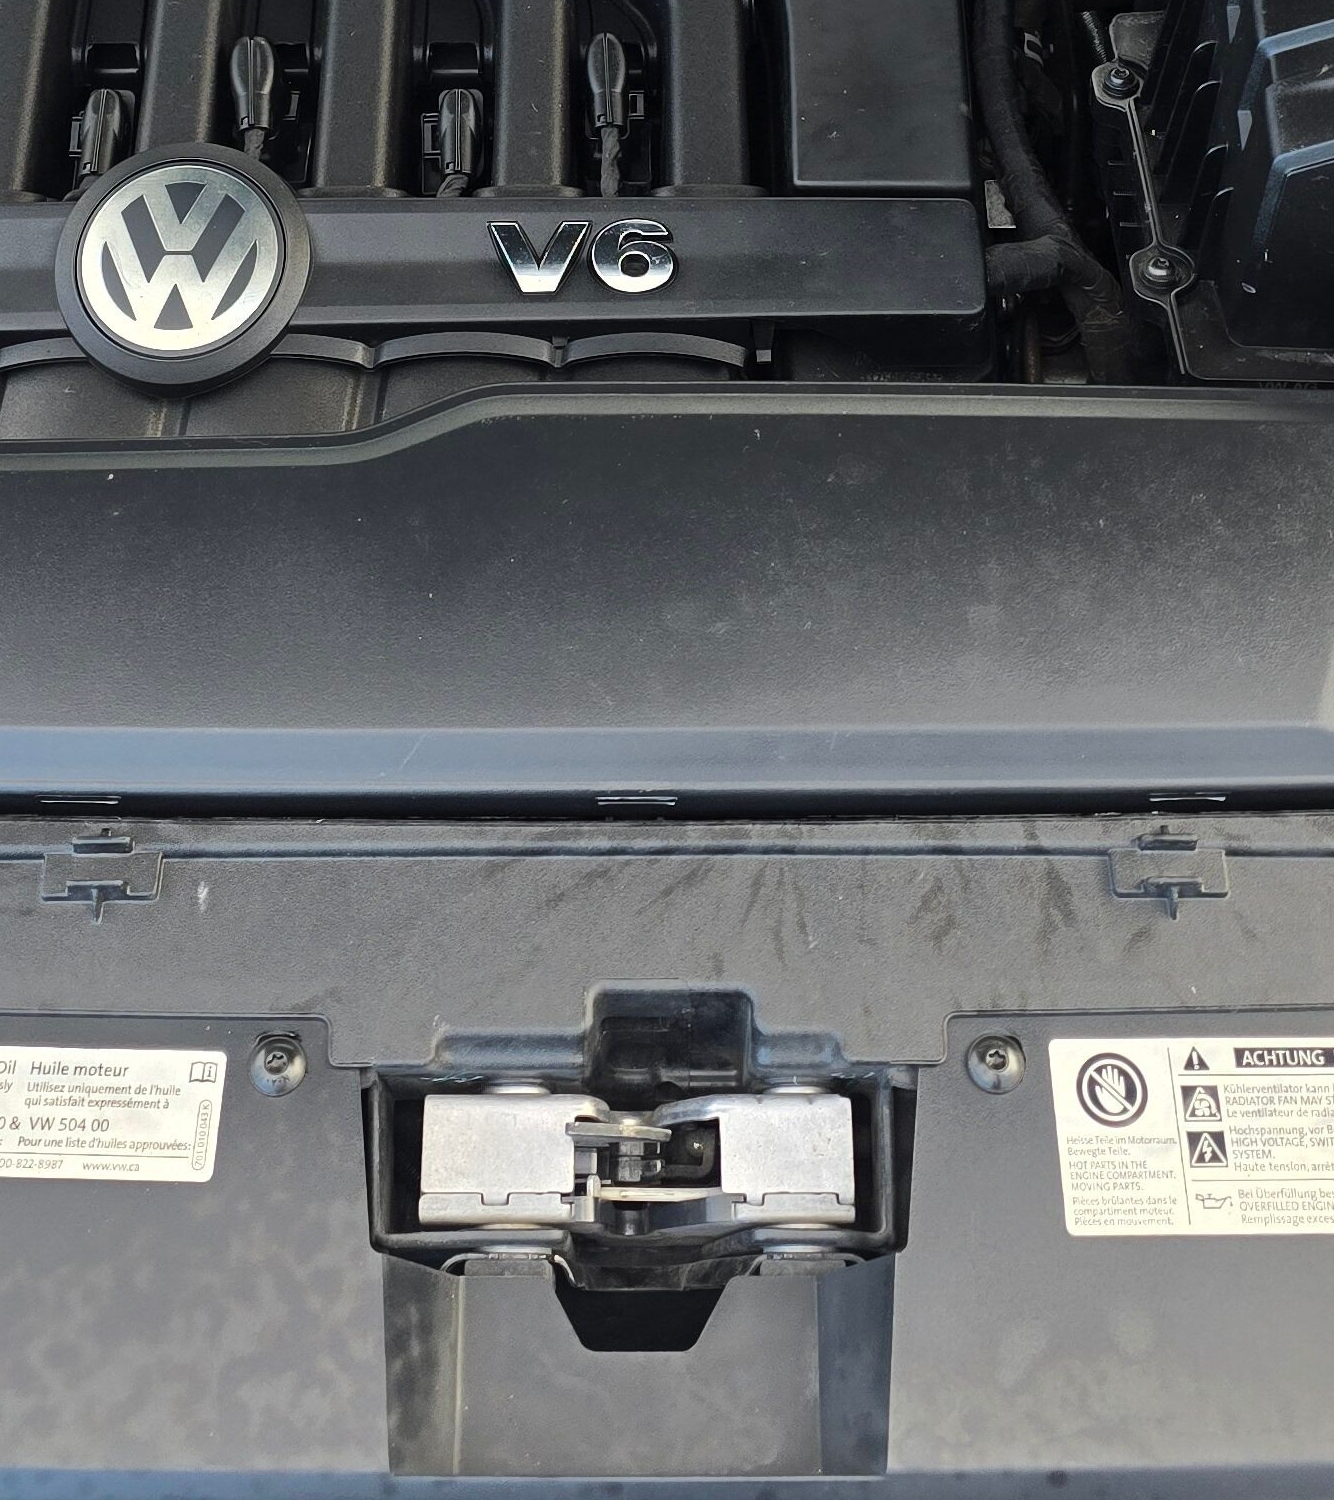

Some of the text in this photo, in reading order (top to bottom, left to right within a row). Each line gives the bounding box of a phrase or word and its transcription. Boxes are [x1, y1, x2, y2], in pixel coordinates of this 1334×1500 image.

[486, 218, 679, 295] V6
[1241, 1048, 1326, 1067] ACHTUNG
[29, 1060, 130, 1078] Huile moteur
[26, 1080, 182, 1097] Utilisez uniquement de l'huile
[1222, 1082, 1304, 1098] Kühlerventilator
[1304, 1082, 1333, 1098] kann
[23, 1094, 171, 1111] qui satisfait expressément à
[1224, 1095, 1277, 1107] RADIATOR
[1276, 1094, 1299, 1107] FAN
[1299, 1094, 1324, 1107] MAY
[8, 1115, 22, 1131] &
[28, 1115, 56, 1132] VW
[57, 1117, 87, 1133] 504
[90, 1117, 111, 1133] 00
[16, 1135, 192, 1153] Pour une liste d'huiles approuvées:
[1230, 1136, 1259, 1148] HIGH
[1258, 1134, 1309, 1150] VOLTAGE,
[1231, 1148, 1276, 1160] SYSTEM.
[82, 1162, 141, 1173] www.vw.ca
[1238, 1200, 1300, 1213] OVERFILLED
